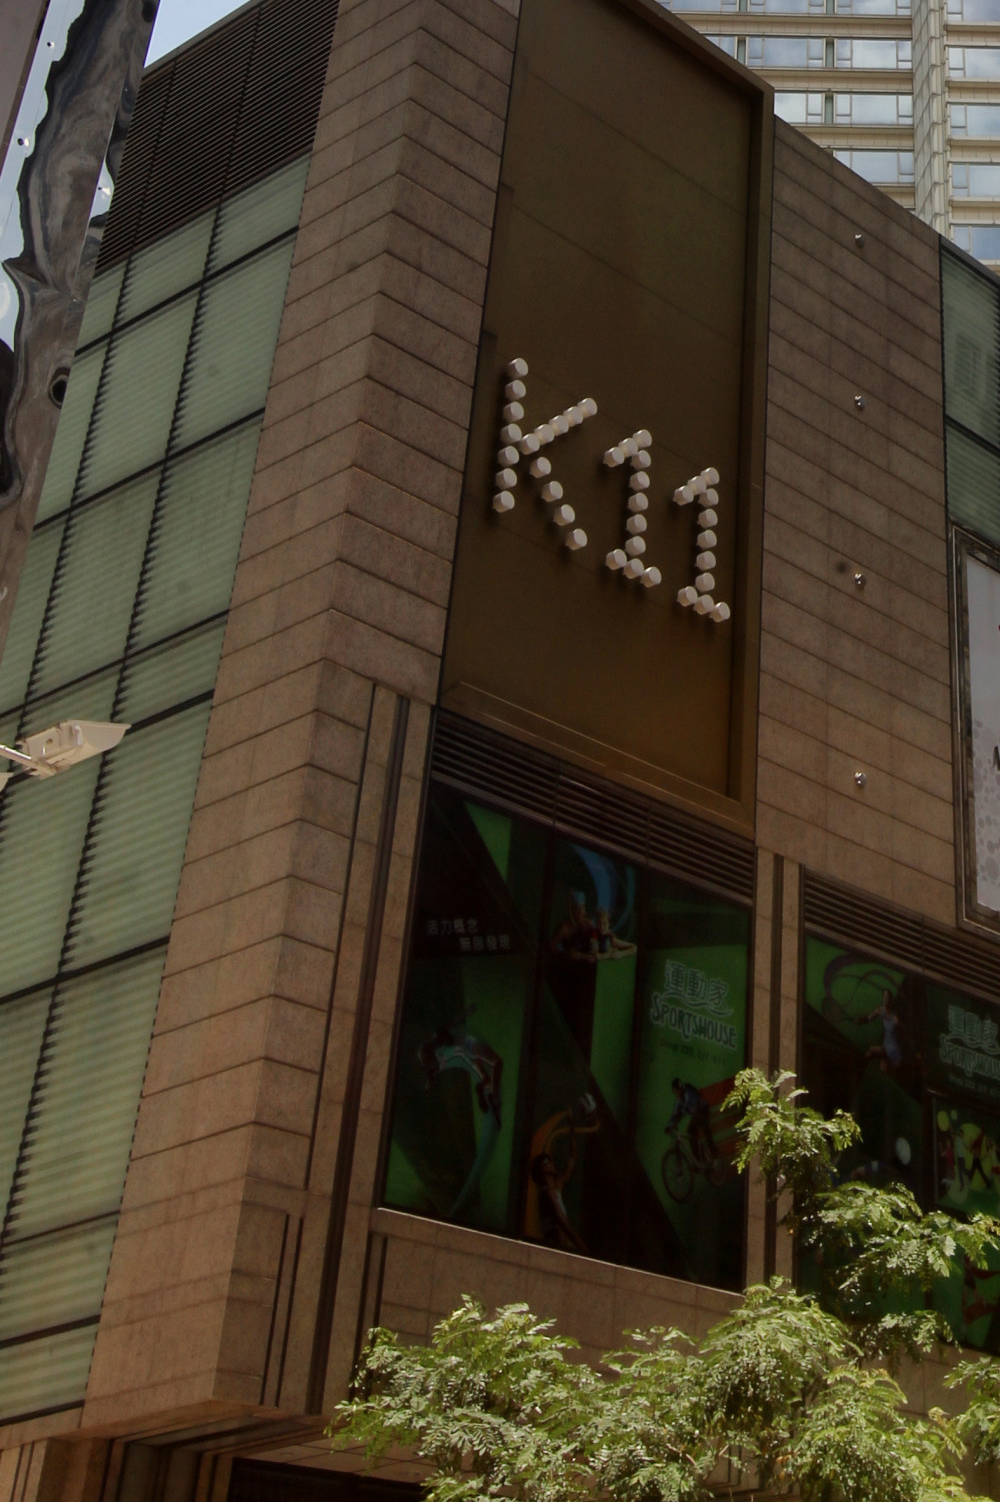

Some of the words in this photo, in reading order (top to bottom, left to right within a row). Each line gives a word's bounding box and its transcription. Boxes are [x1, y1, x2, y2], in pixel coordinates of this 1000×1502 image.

[493, 358, 731, 623] K11
[664, 959, 730, 1010] 運動家
